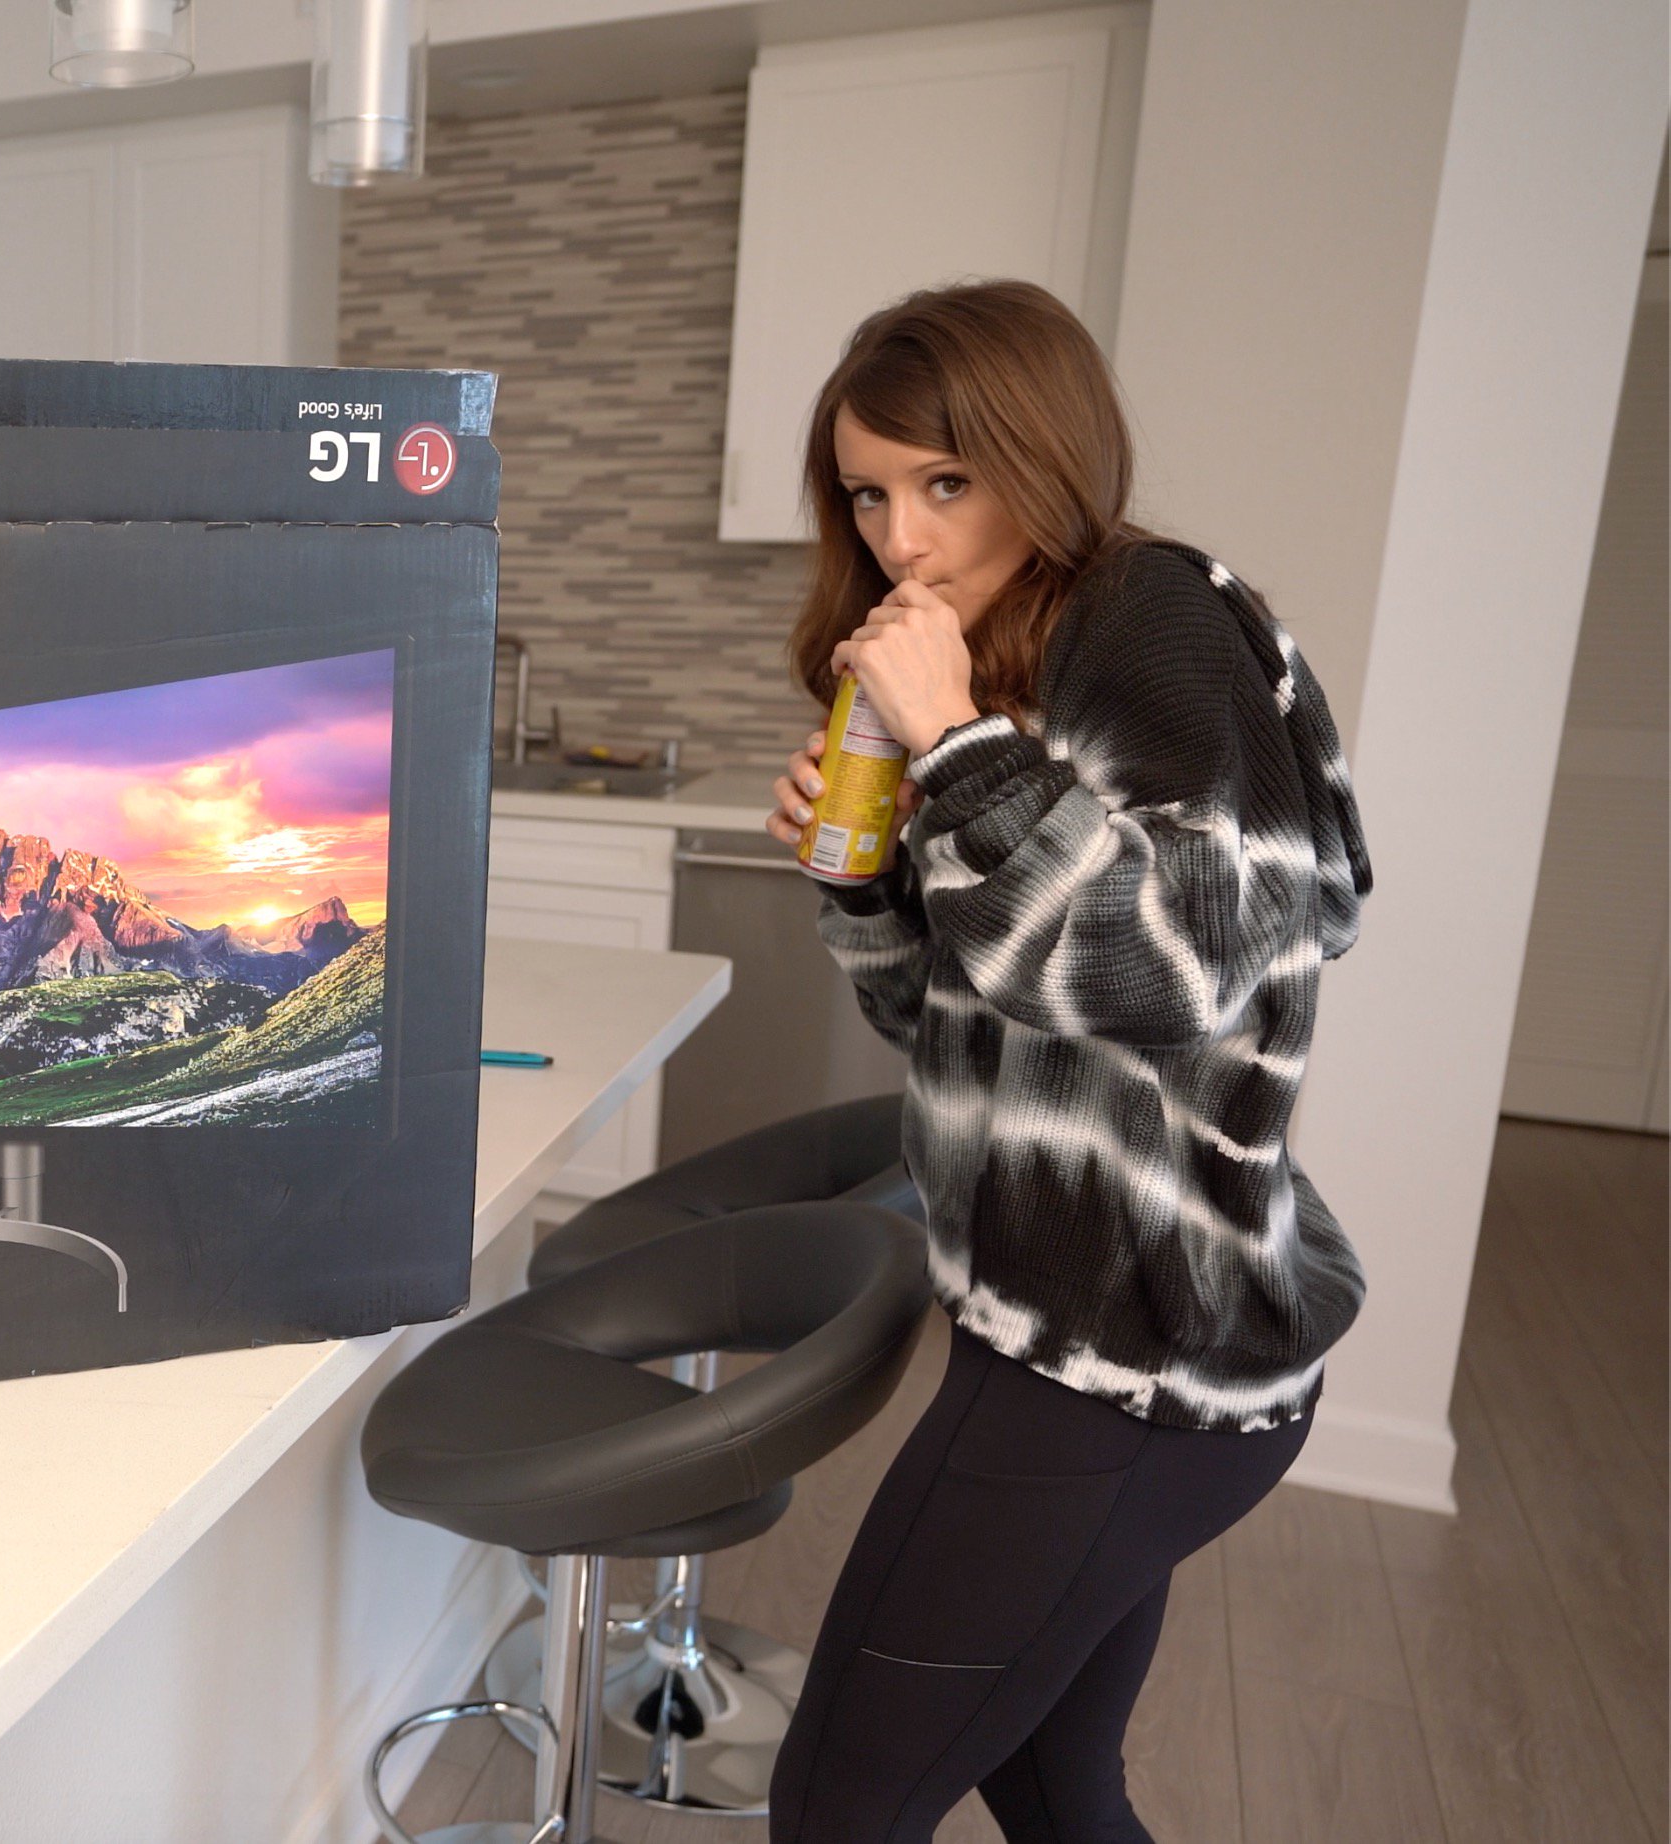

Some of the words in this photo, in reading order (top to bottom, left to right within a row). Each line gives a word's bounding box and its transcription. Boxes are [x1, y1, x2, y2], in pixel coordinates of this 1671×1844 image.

[299, 402, 339, 418] Good
[345, 403, 382, 420] Life's
[309, 431, 380, 482] LG
